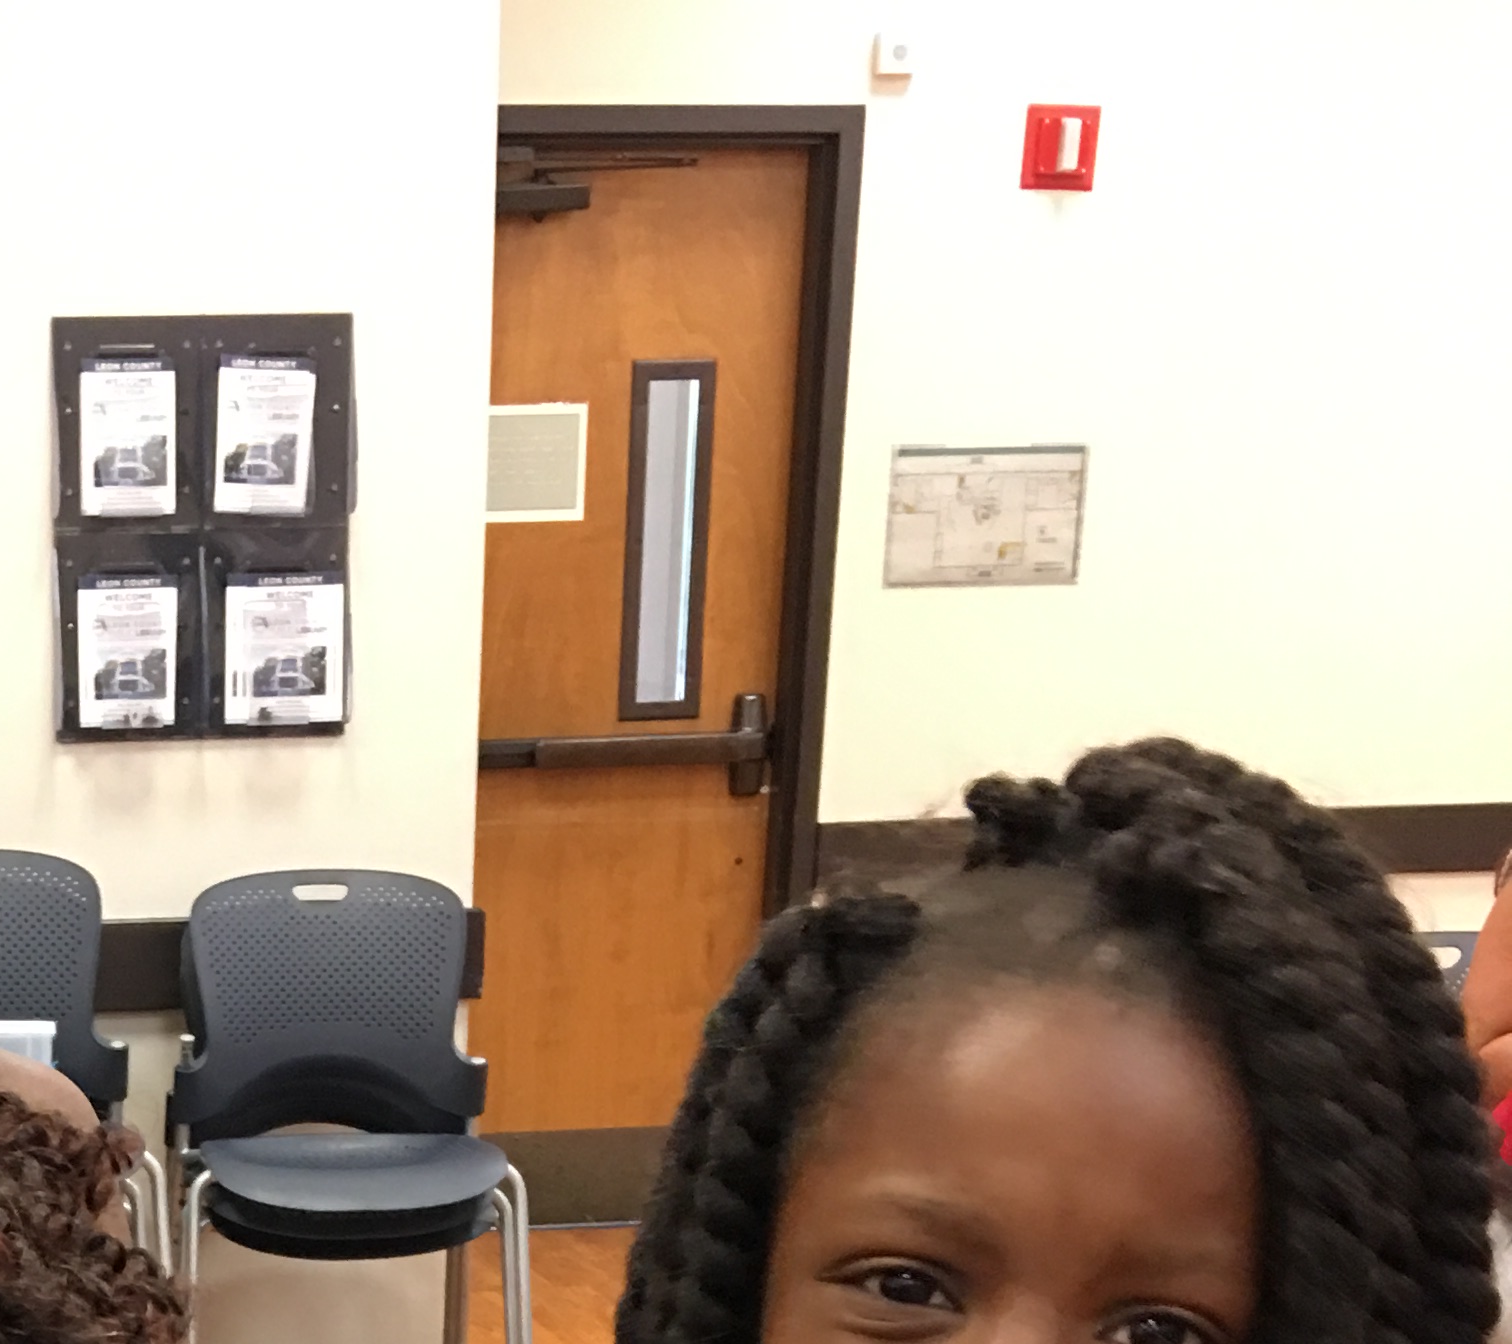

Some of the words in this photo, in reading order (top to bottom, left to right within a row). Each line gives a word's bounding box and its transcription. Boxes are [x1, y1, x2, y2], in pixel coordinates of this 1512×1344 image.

[122, 361, 162, 371] COUNTY
[257, 359, 297, 368] COUNTY
[122, 578, 162, 587] COUNTY
[285, 576, 323, 585] COUNTY
